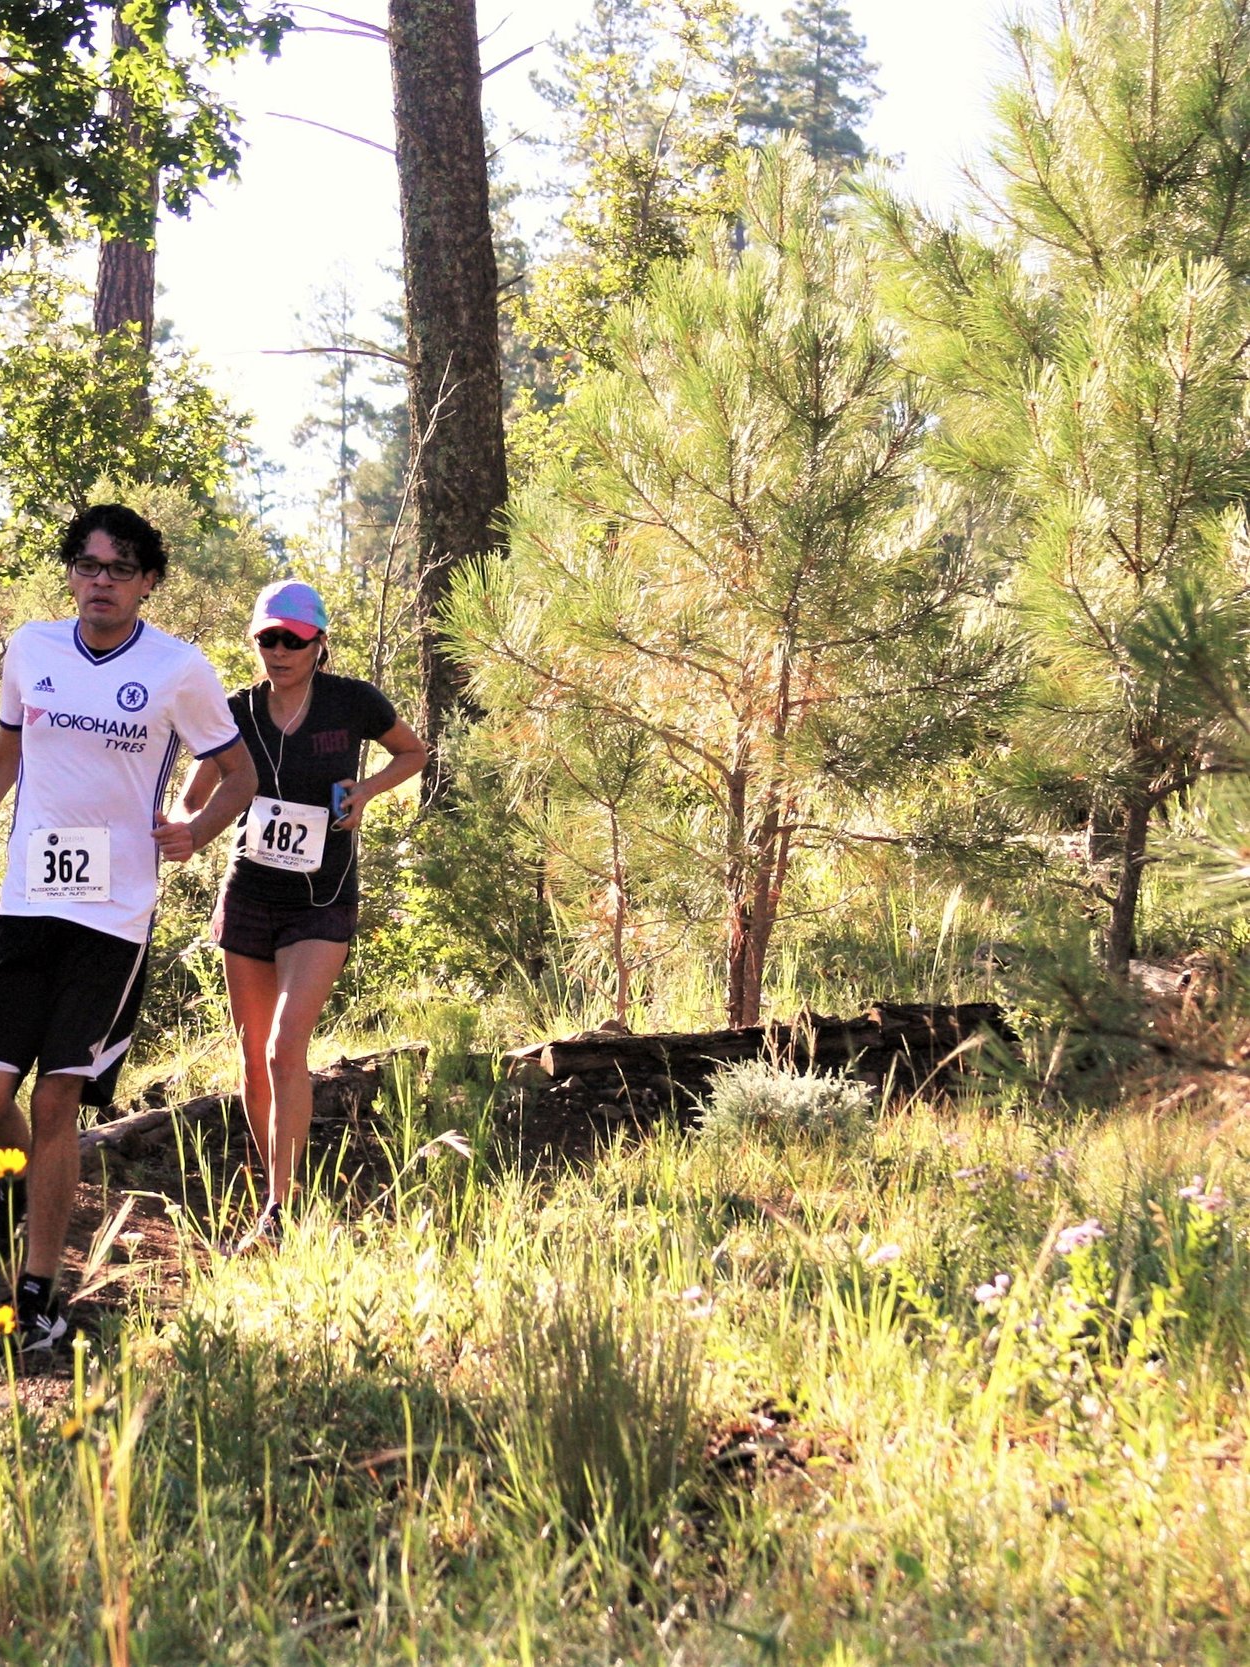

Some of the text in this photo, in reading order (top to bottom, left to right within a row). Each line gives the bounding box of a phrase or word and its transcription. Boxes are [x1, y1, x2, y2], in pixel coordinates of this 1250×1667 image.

[48, 712, 148, 740] YOKOHAMA
[105, 739, 146, 753] TYRES
[262, 819, 308, 855] 482
[43, 849, 90, 884] 362
